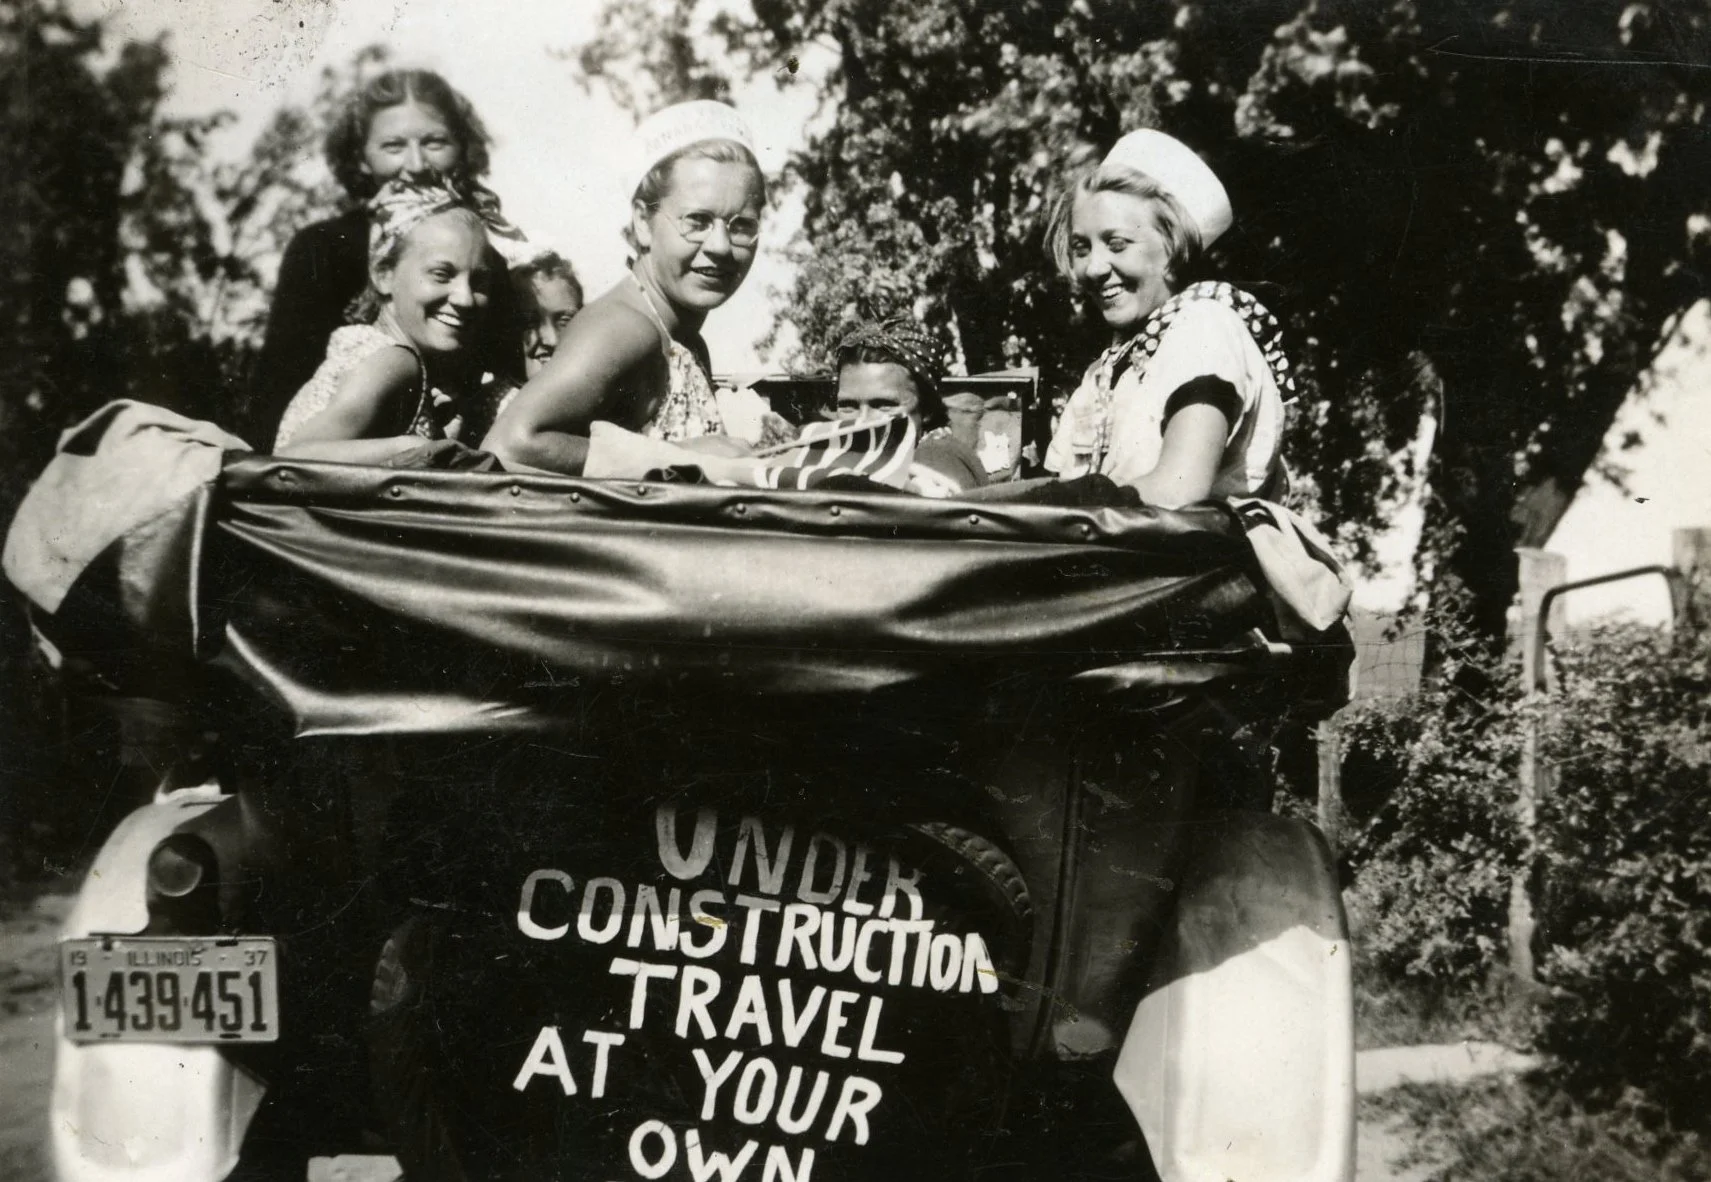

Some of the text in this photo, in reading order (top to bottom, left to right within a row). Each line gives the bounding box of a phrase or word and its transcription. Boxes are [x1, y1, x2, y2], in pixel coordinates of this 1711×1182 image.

[656, 806, 928, 922] UNDER
[127, 950, 203, 967] ILLINOIS
[244, 950, 268, 966] 37
[517, 868, 999, 995] CONSTRUCTION
[609, 957, 906, 1065] TRAVEL
[512, 1026, 884, 1146] AT YOUR
[628, 1119, 817, 1182] OWN
